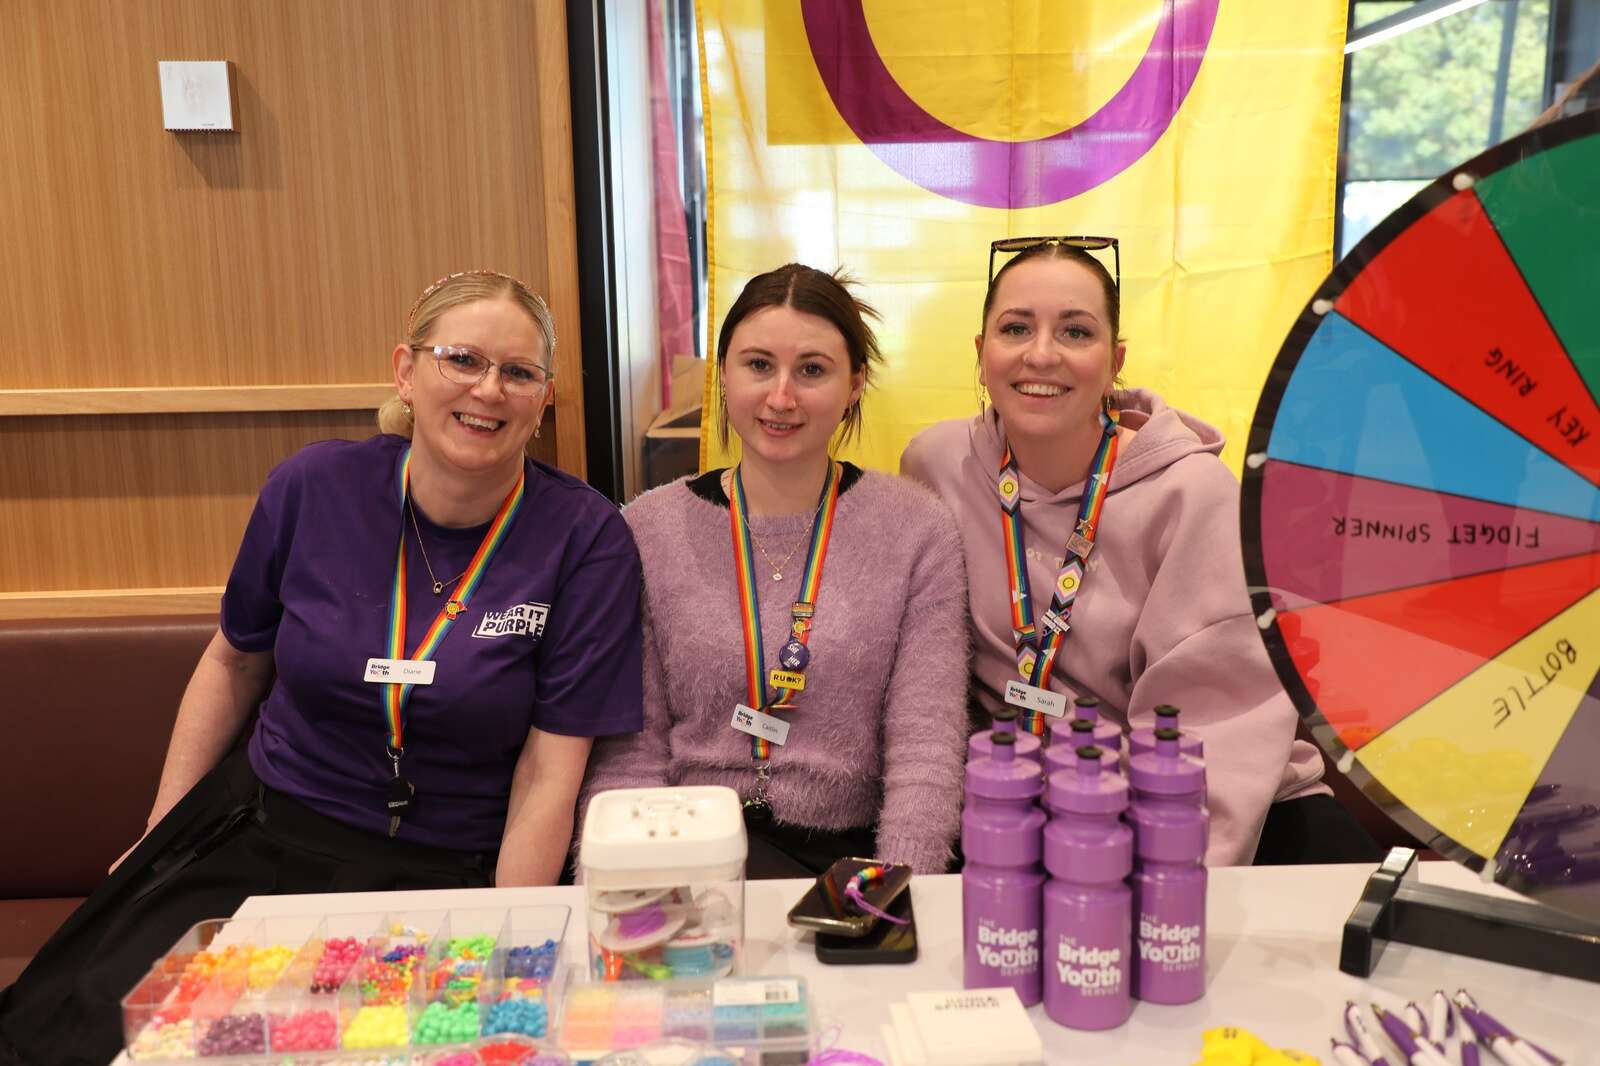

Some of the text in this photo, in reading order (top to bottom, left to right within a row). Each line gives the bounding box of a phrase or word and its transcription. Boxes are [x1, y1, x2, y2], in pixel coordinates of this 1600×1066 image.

[1485, 347, 1590, 447] KEY RING
[1332, 516, 1540, 549] FIDGET SPINNER
[485, 606, 544, 622] WEAR IT
[483, 618, 543, 638] PURPLE
[1492, 638, 1577, 729] BOTTLE
[1008, 691, 1026, 701] Yoth
[736, 715, 752, 727] Yoth
[978, 925, 1038, 948] Bridge
[1139, 921, 1200, 944] Bridge
[975, 943, 1039, 967] Youth
[1058, 943, 1120, 967] Bridge
[1137, 939, 1200, 963] Youth
[1056, 960, 1121, 988] Youth
